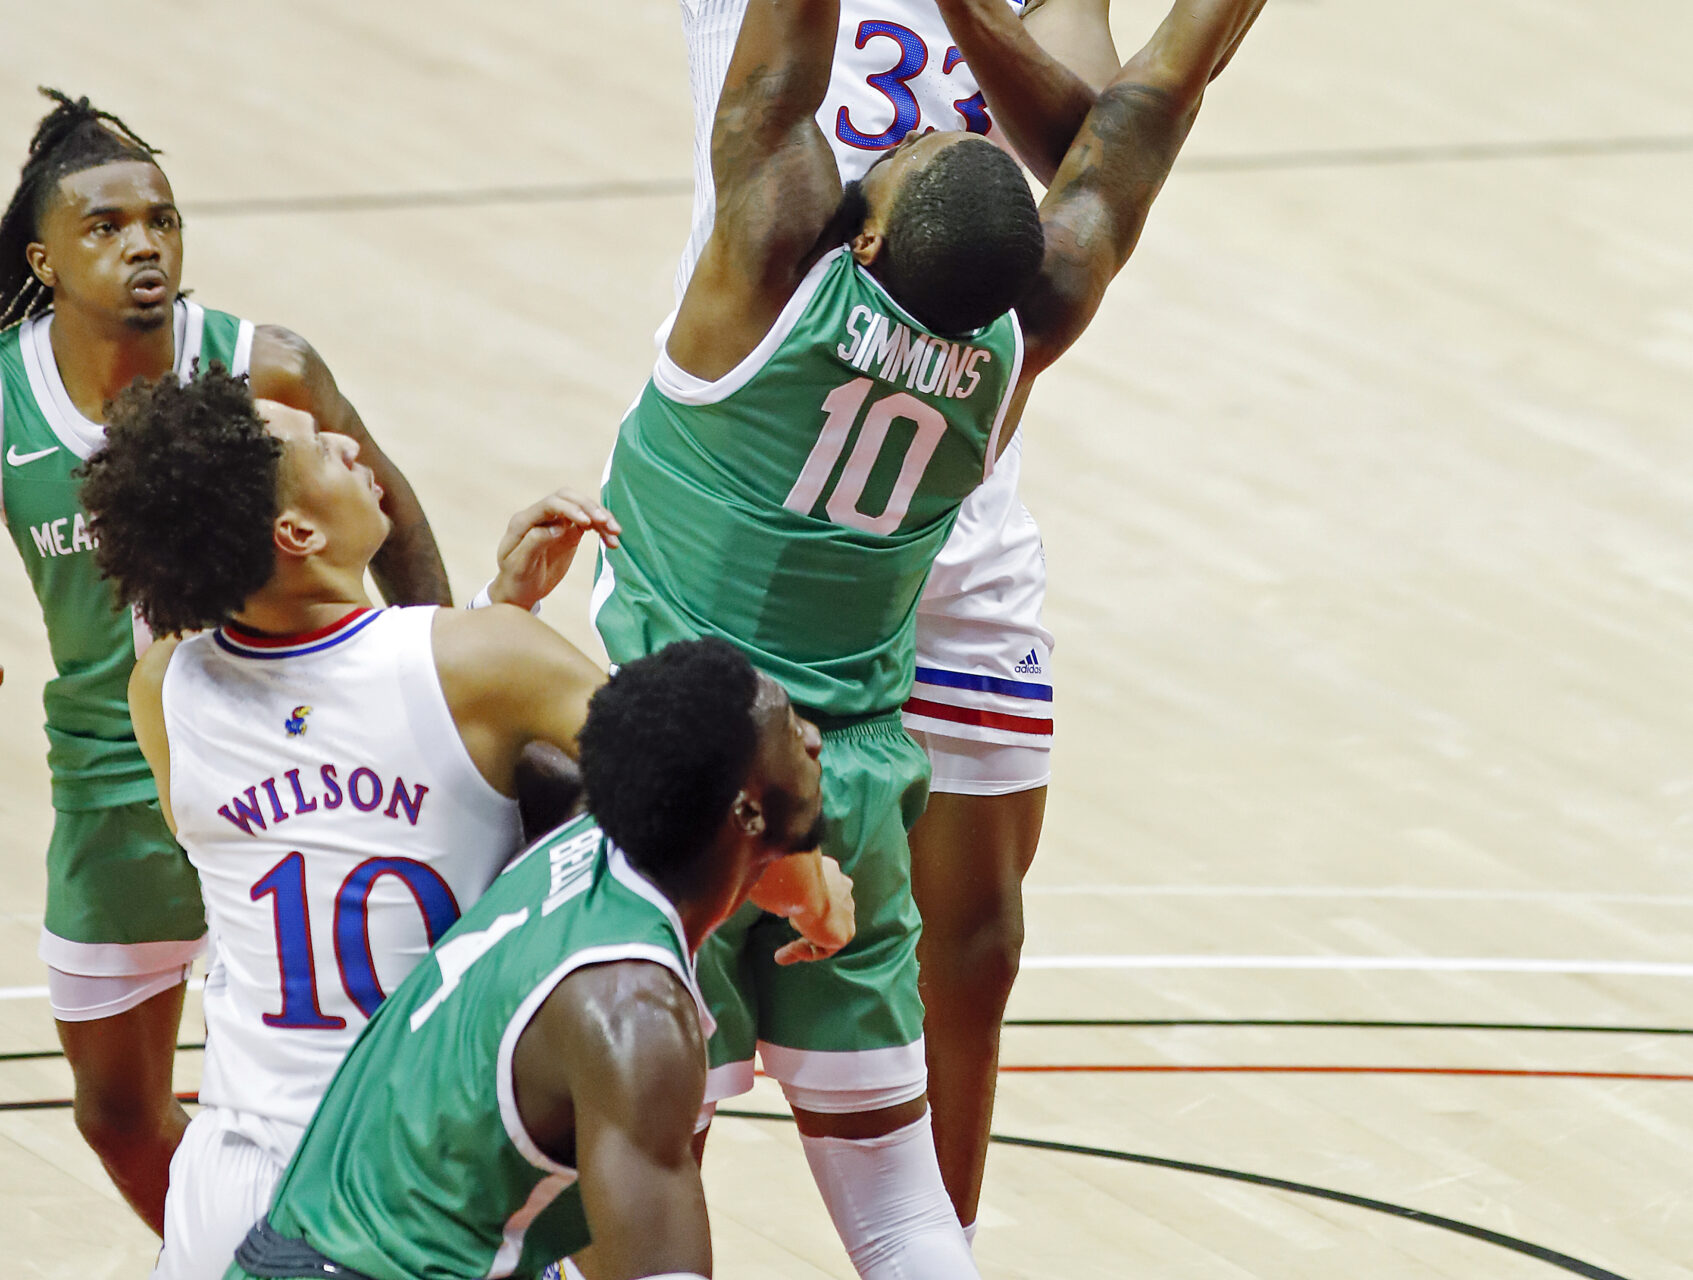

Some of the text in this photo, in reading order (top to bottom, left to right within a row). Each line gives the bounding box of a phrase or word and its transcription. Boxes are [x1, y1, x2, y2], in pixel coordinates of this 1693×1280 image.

[836, 304, 991, 399] SIMMONS
[783, 376, 949, 537] 10
[29, 512, 100, 558] MEA
[1014, 664, 1042, 675] adidas
[217, 763, 429, 837] WILSON
[250, 850, 461, 1031] 10
